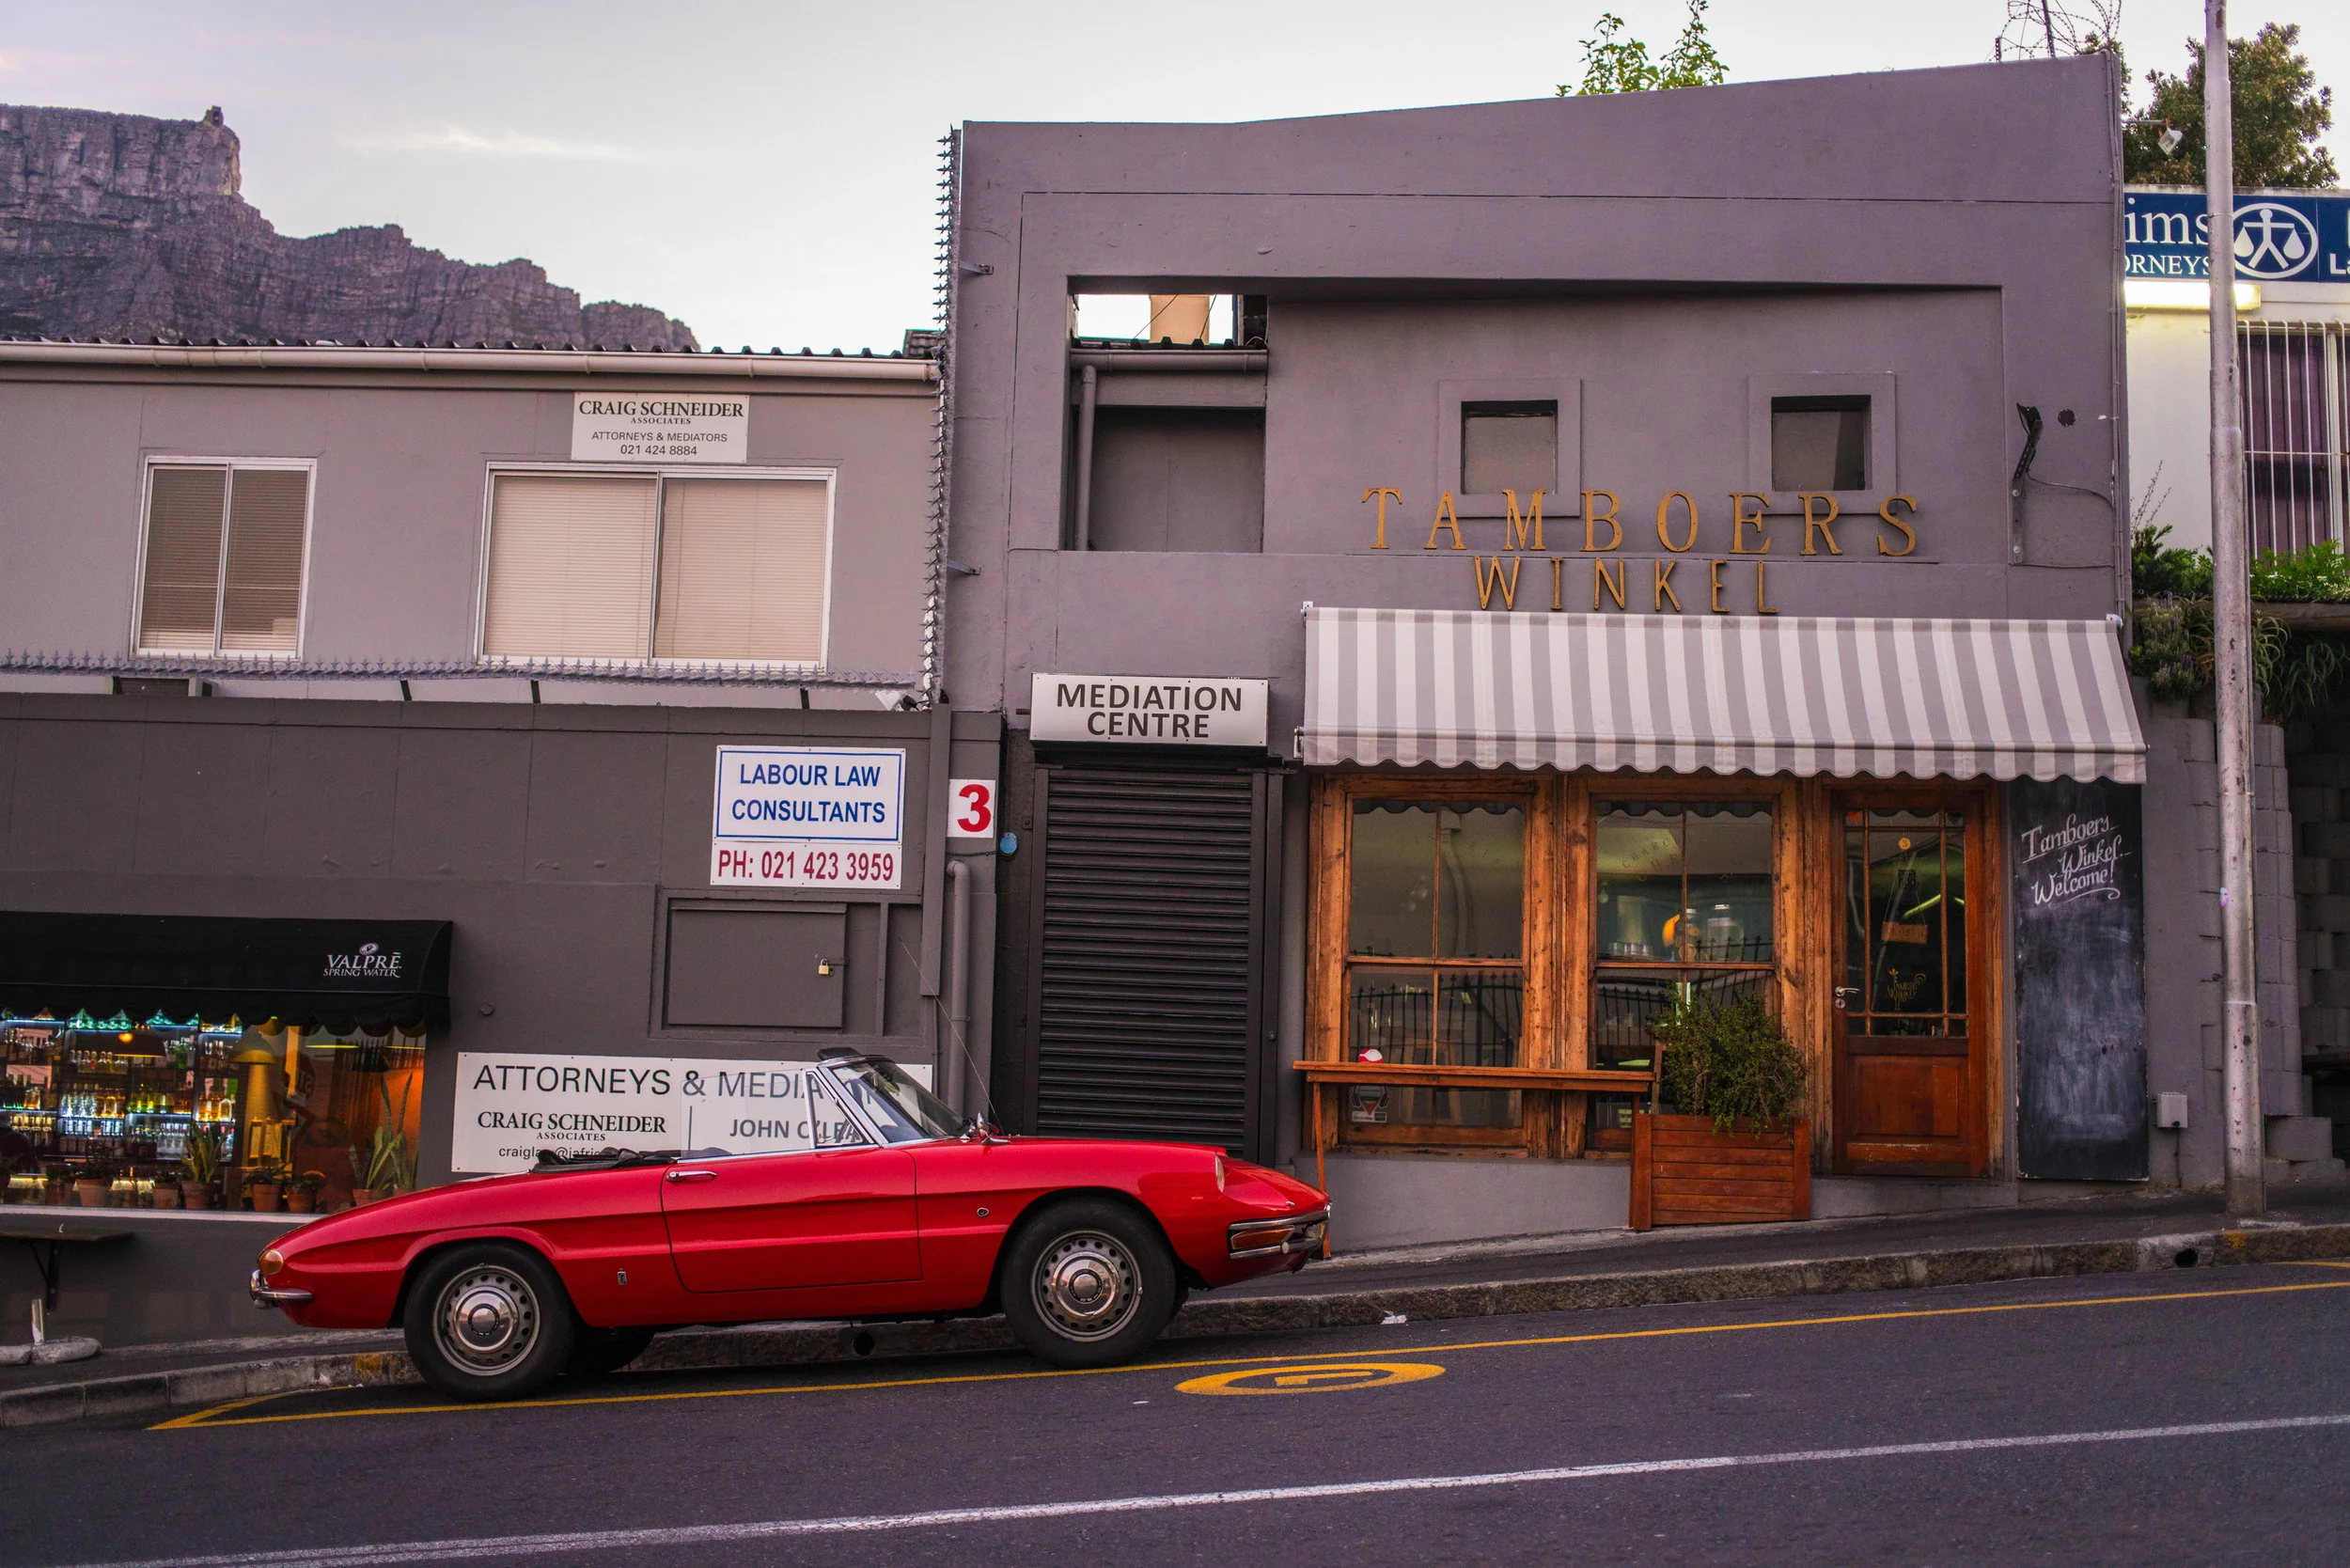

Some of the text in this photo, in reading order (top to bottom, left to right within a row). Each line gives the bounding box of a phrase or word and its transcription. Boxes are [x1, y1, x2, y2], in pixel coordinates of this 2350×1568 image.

[579, 400, 744, 417] CRAIG SCHNEIDER
[630, 416, 692, 425] ASSOCIATES
[591, 431, 728, 443] ATTORNEYS & MEDIATORS
[620, 445, 697, 456] 021 424 8884
[1361, 487, 1918, 557] TAMBOERS
[1474, 556, 1778, 615] WINKEL
[1057, 683, 1241, 712] MEDIATION
[1088, 712, 1209, 738] CENTRE
[740, 763, 881, 787] LABOUR LAW
[731, 799, 885, 823] CONSULTANTS
[957, 784, 992, 833] 3
[2021, 813, 2109, 858] Tamboers
[718, 850, 893, 882] PH: 021 423 3959
[2031, 859, 2114, 904] Welcome!
[323, 968, 401, 978] SPRING WATER
[473, 1065, 671, 1096] ATTORNEYS
[682, 1067, 706, 1097] &
[478, 1110, 542, 1130] CRAIG
[548, 1113, 666, 1134] SCHNEIDER
[730, 1119, 790, 1138] JOHN
[537, 1132, 606, 1141] ASSOCIATES
